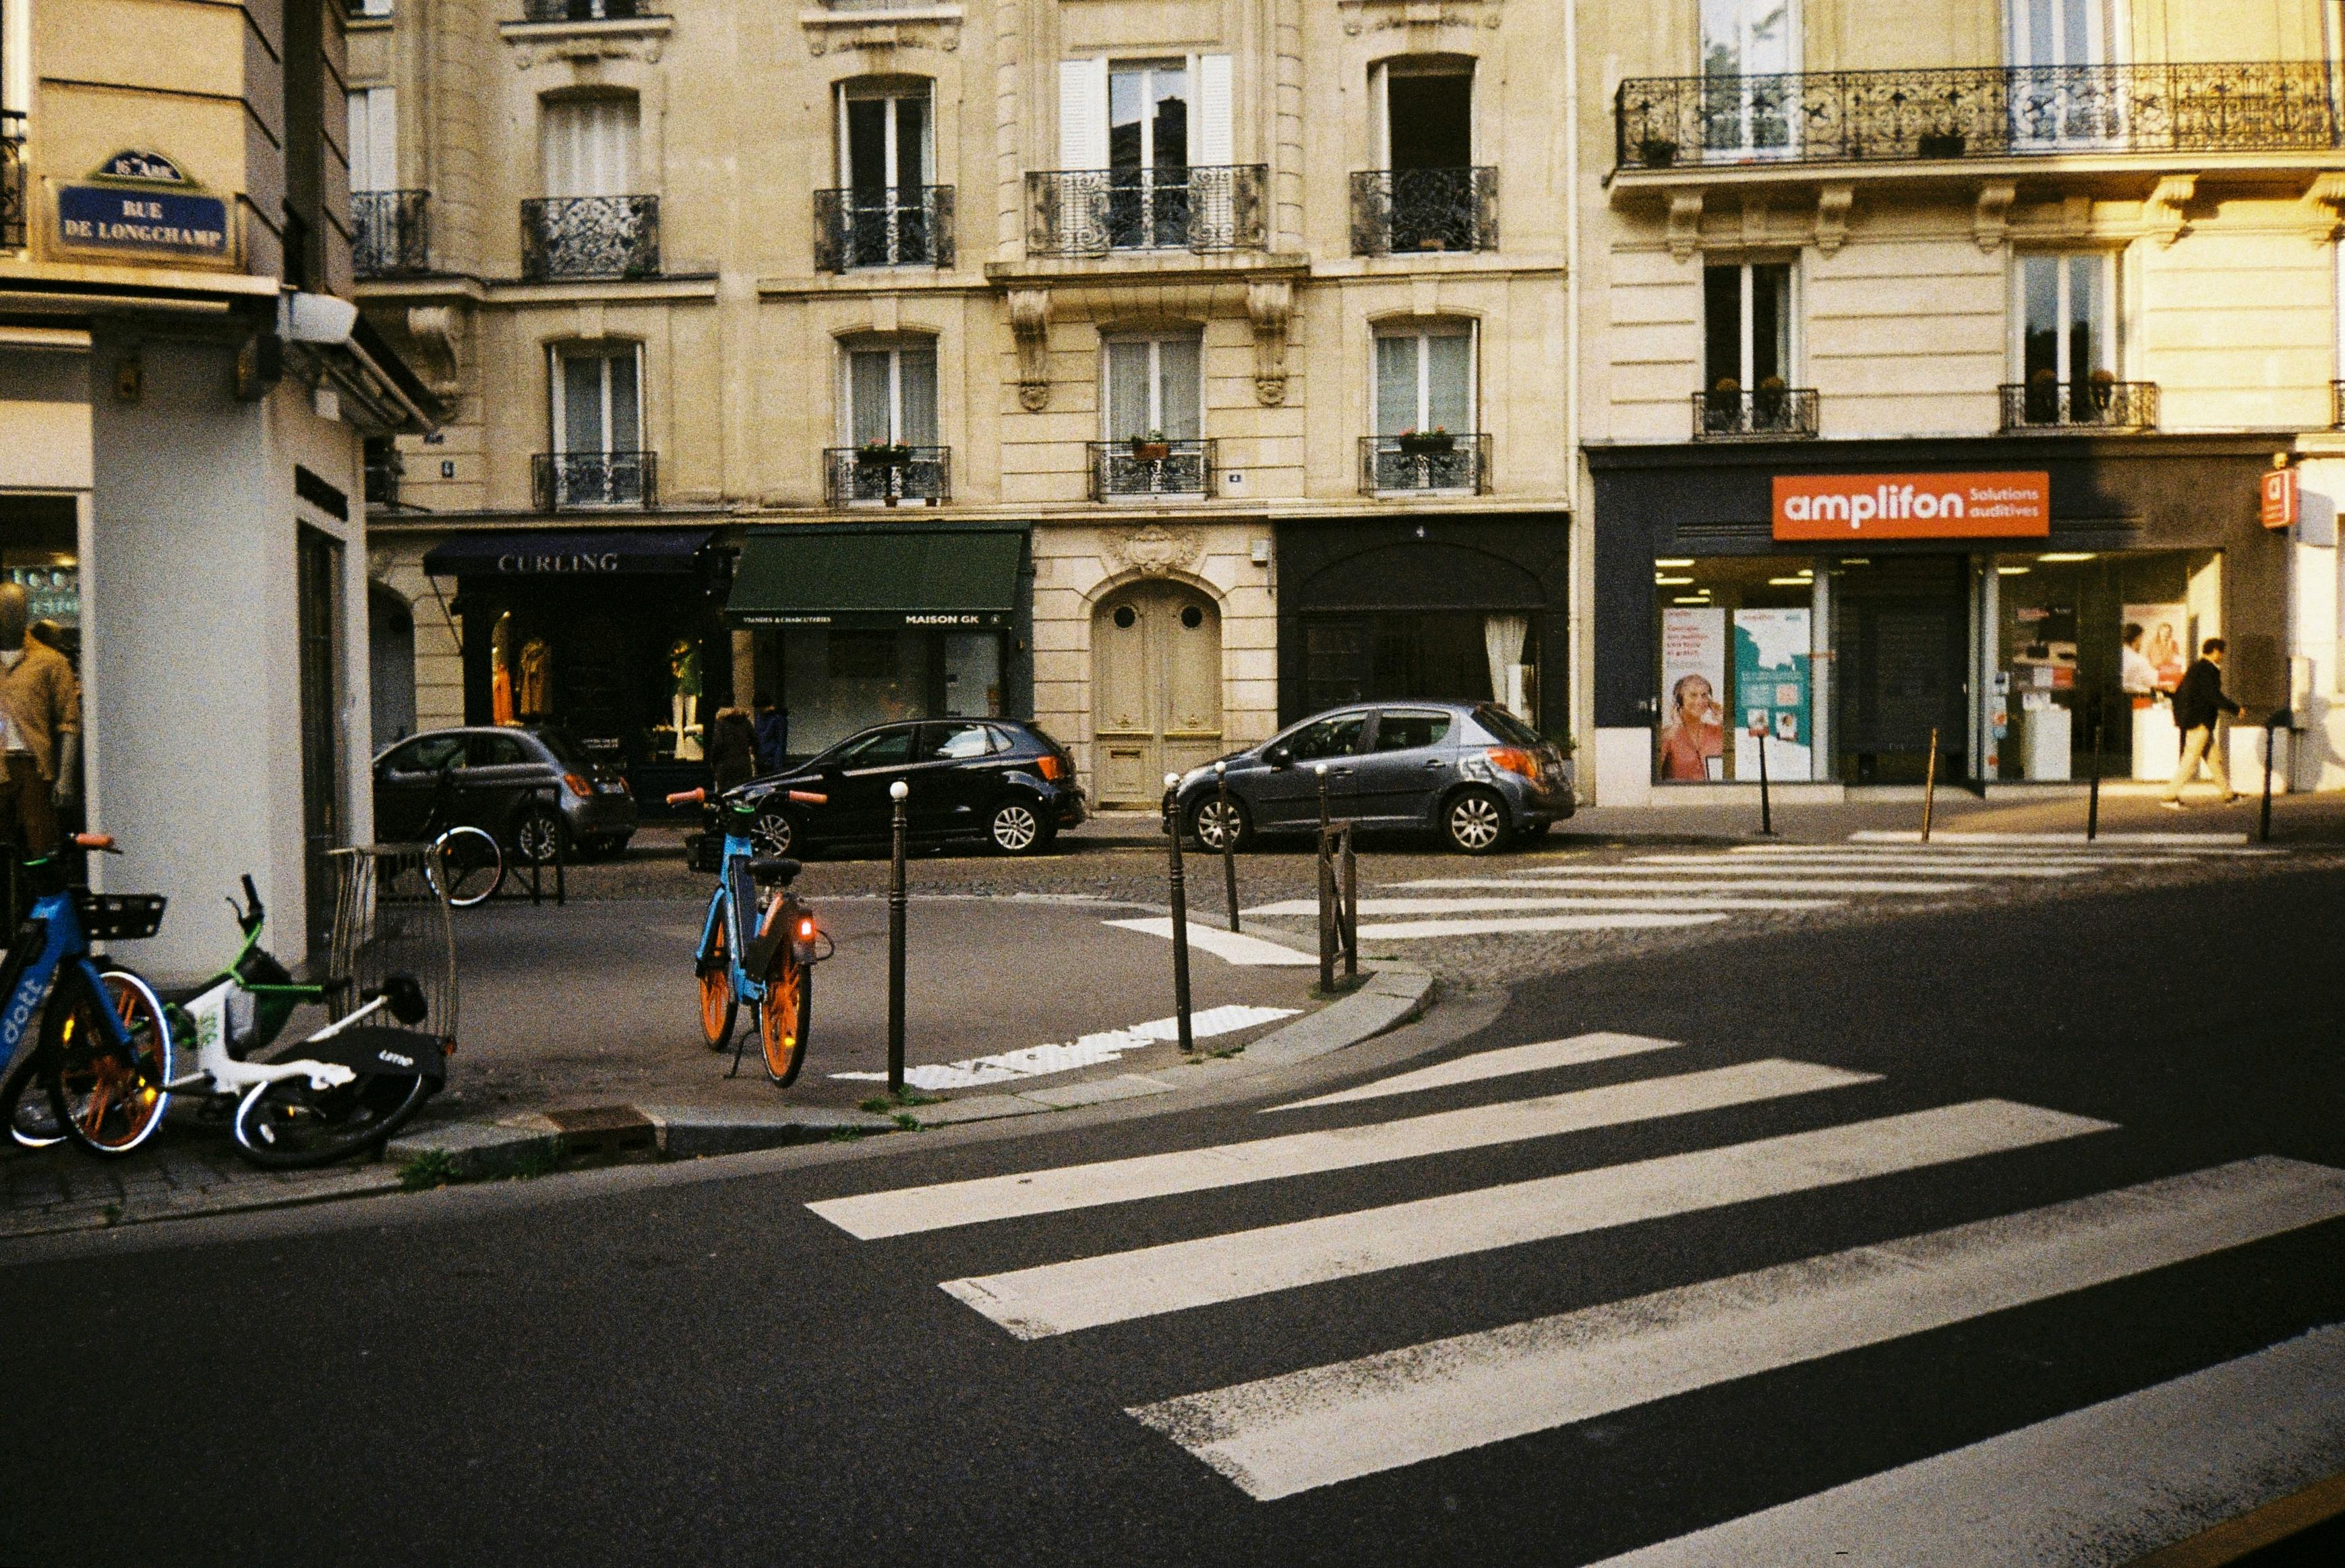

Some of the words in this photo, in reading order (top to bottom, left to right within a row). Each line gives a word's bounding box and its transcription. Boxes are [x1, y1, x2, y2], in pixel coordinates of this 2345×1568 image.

[123, 200, 163, 219] RUE
[65, 219, 93, 237] DE
[98, 221, 222, 248] LONGCHAMP
[1969, 486, 2040, 502] Solutions
[1783, 483, 1964, 529] amplifon
[1969, 504, 2040, 518] auditives
[498, 553, 618, 572] CURLING
[906, 615, 957, 624] MAISON
[960, 615, 980, 624] GK
[4, 978, 42, 1044] dott
